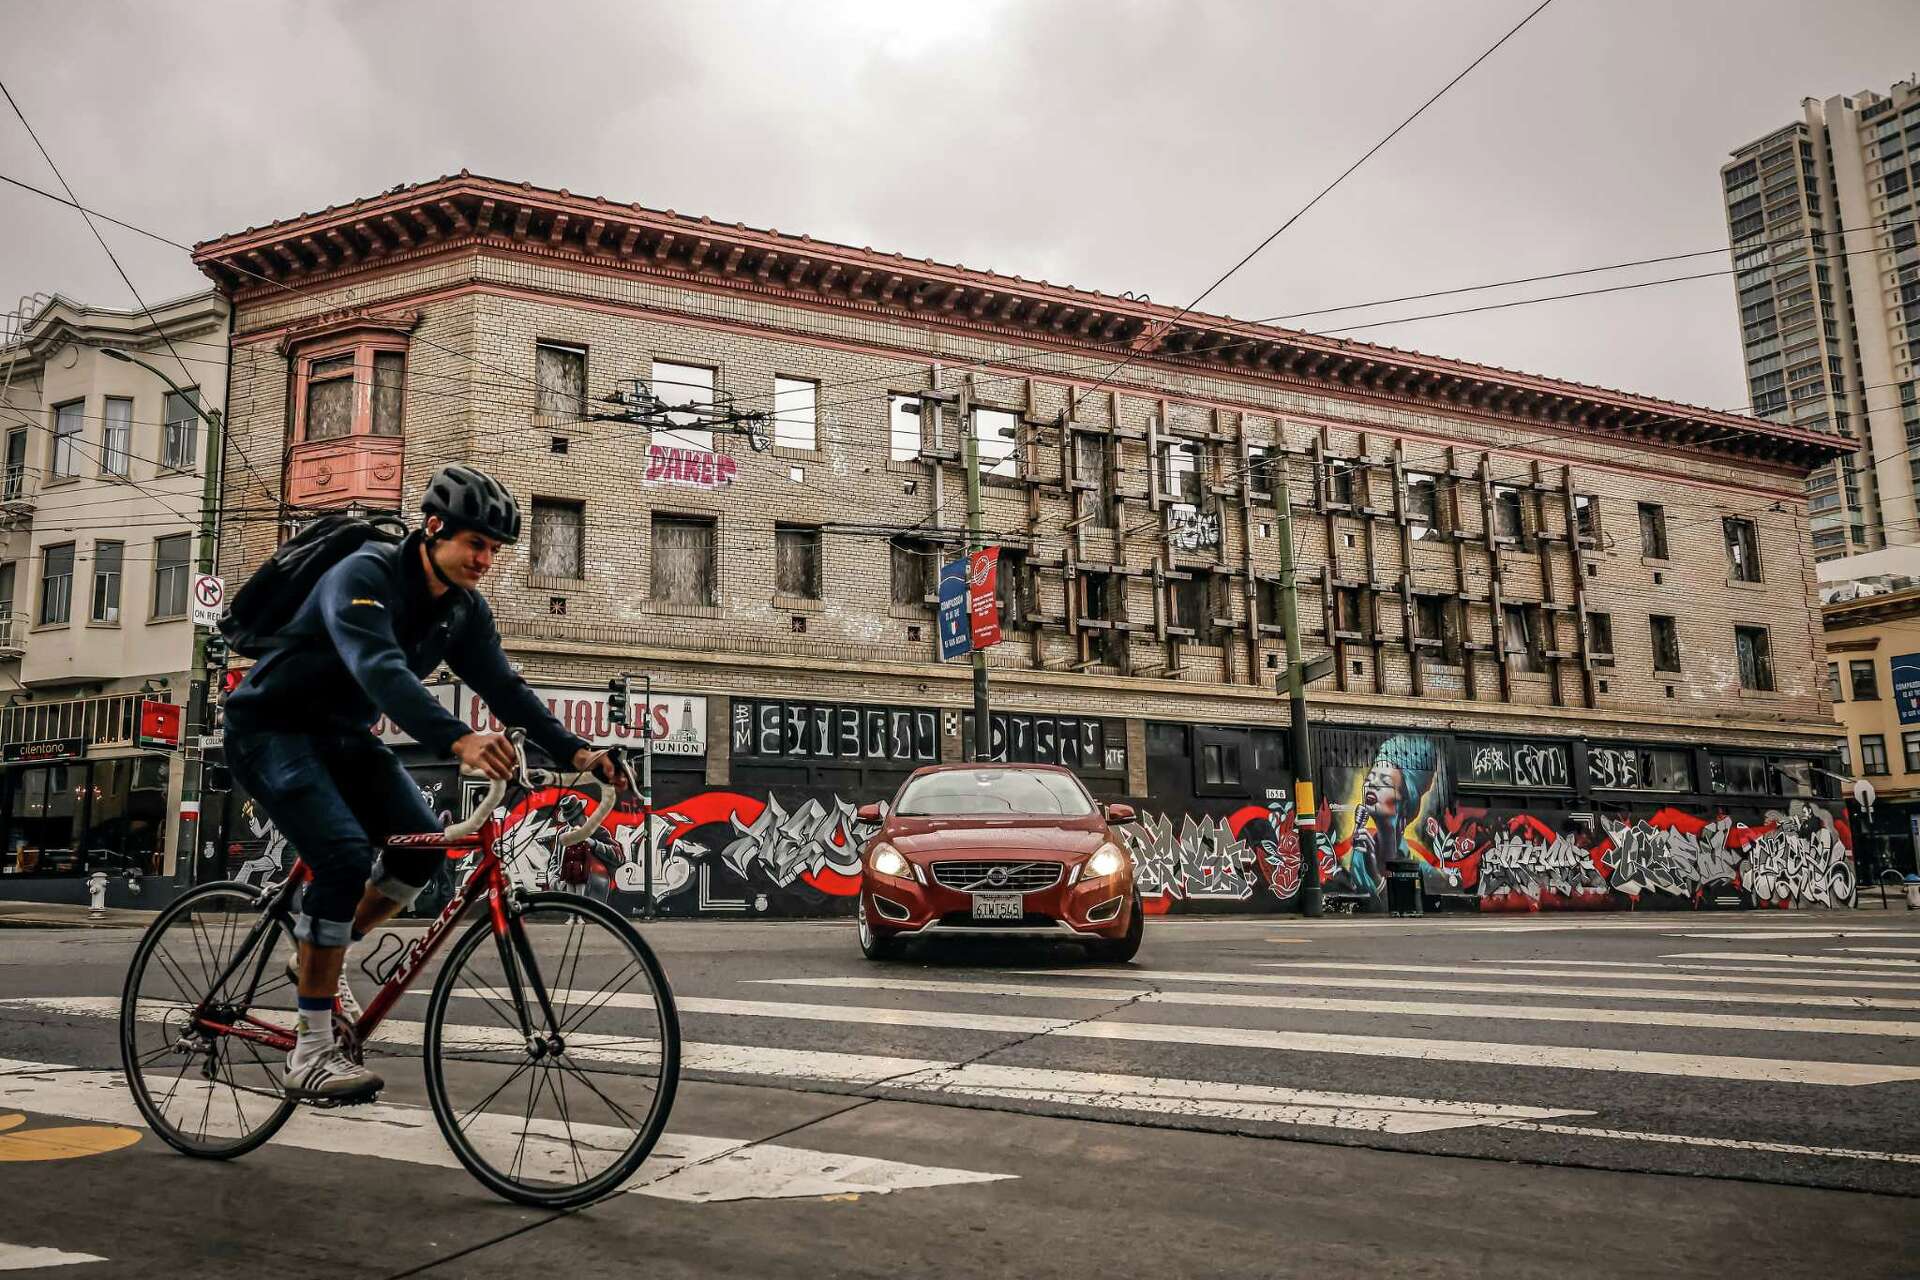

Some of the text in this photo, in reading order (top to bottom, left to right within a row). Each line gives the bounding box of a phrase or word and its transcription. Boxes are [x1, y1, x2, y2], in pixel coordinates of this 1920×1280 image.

[195, 609, 221, 622] ON RED
[736, 705, 751, 749] BTM
[658, 742, 699, 753] UNION
